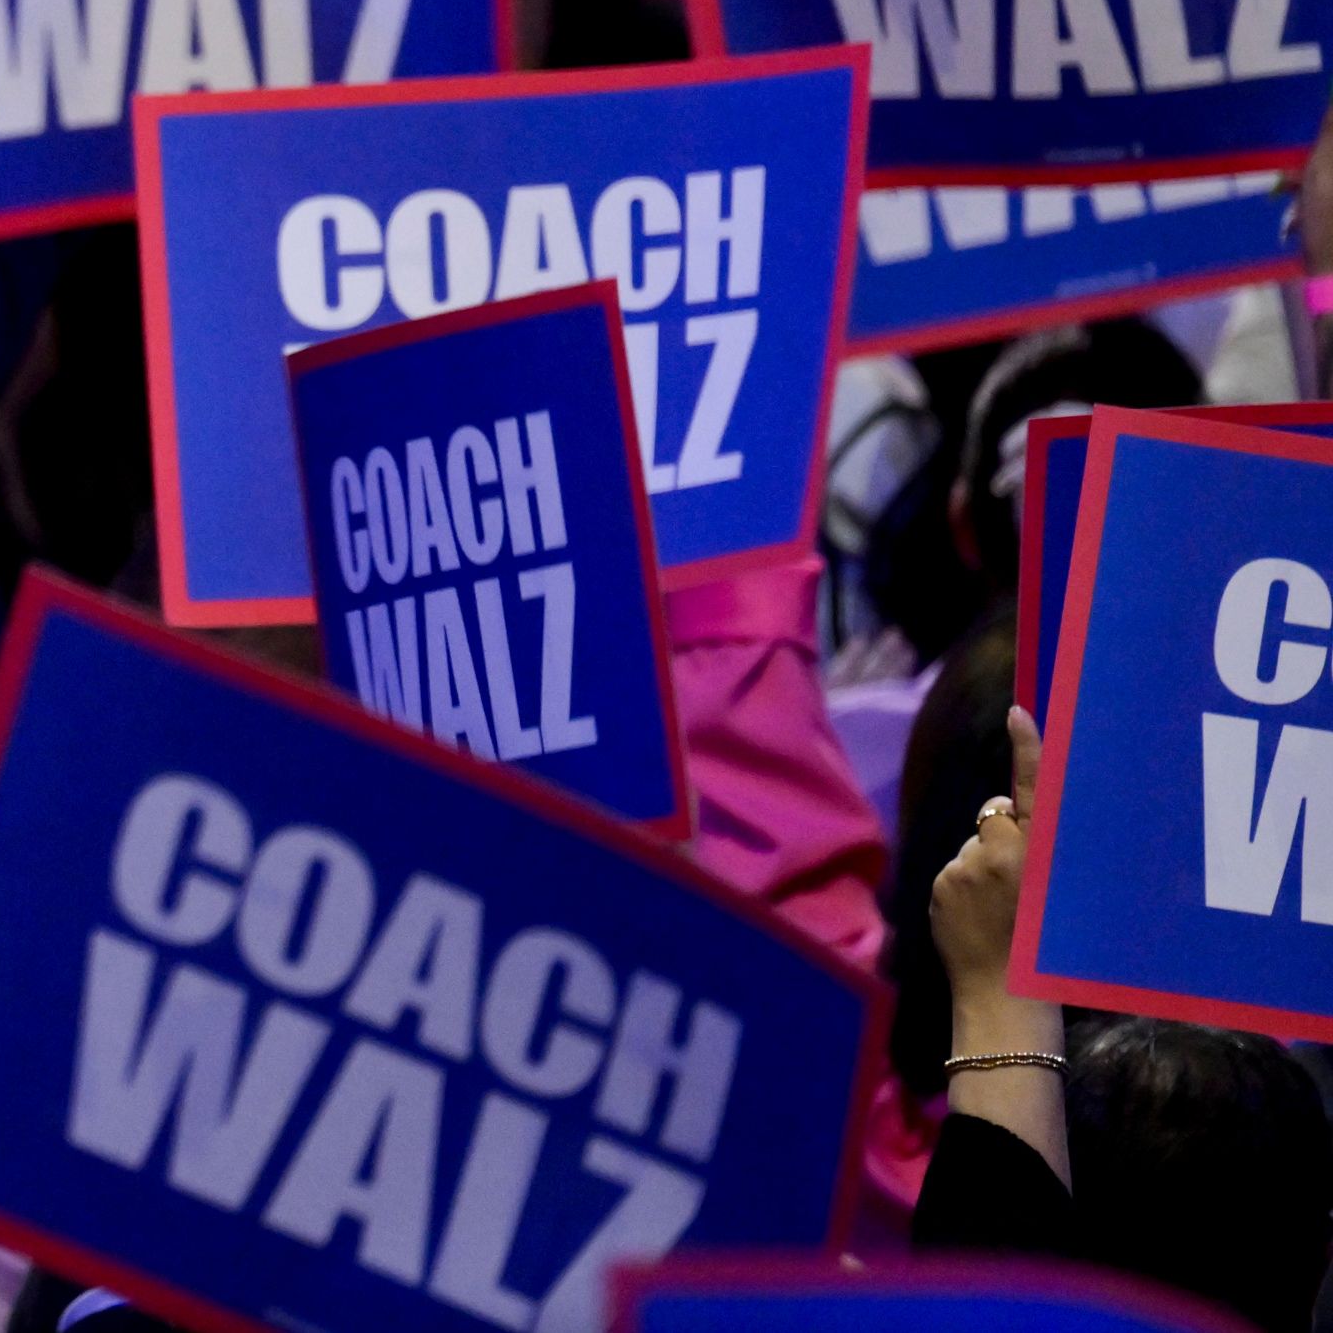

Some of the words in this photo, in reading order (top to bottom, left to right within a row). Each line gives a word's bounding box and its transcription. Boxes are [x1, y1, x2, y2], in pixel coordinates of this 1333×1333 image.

[276, 165, 767, 332] COACH
[331, 409, 568, 594] COACH
[109, 771, 742, 1164] COACH
[65, 927, 707, 1333] WALZ
